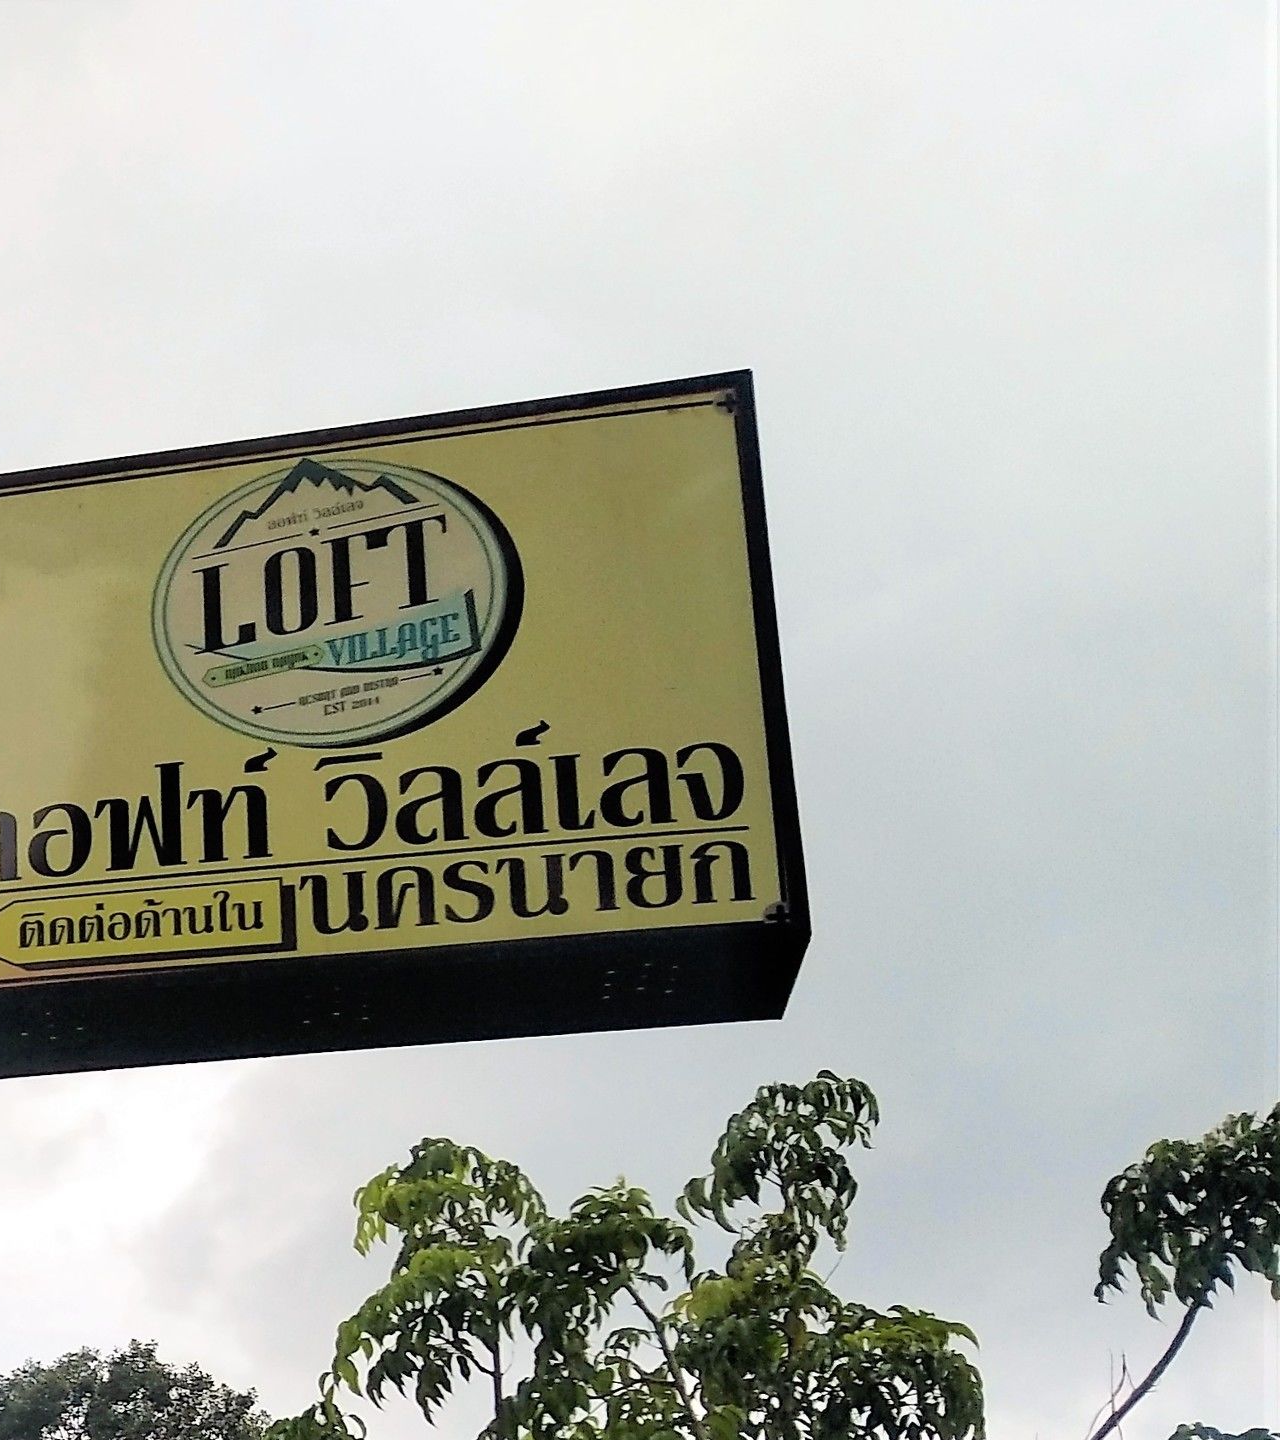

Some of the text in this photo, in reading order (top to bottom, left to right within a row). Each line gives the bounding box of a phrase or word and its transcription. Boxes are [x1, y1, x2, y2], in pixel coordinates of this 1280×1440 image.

[192, 513, 447, 655] LOFT
[324, 612, 461, 664] VILLAGE
[313, 719, 746, 852] วิลล์เลจ
[18, 890, 264, 948] ติดต่อด้านใน
[298, 838, 757, 936] นครนายก
